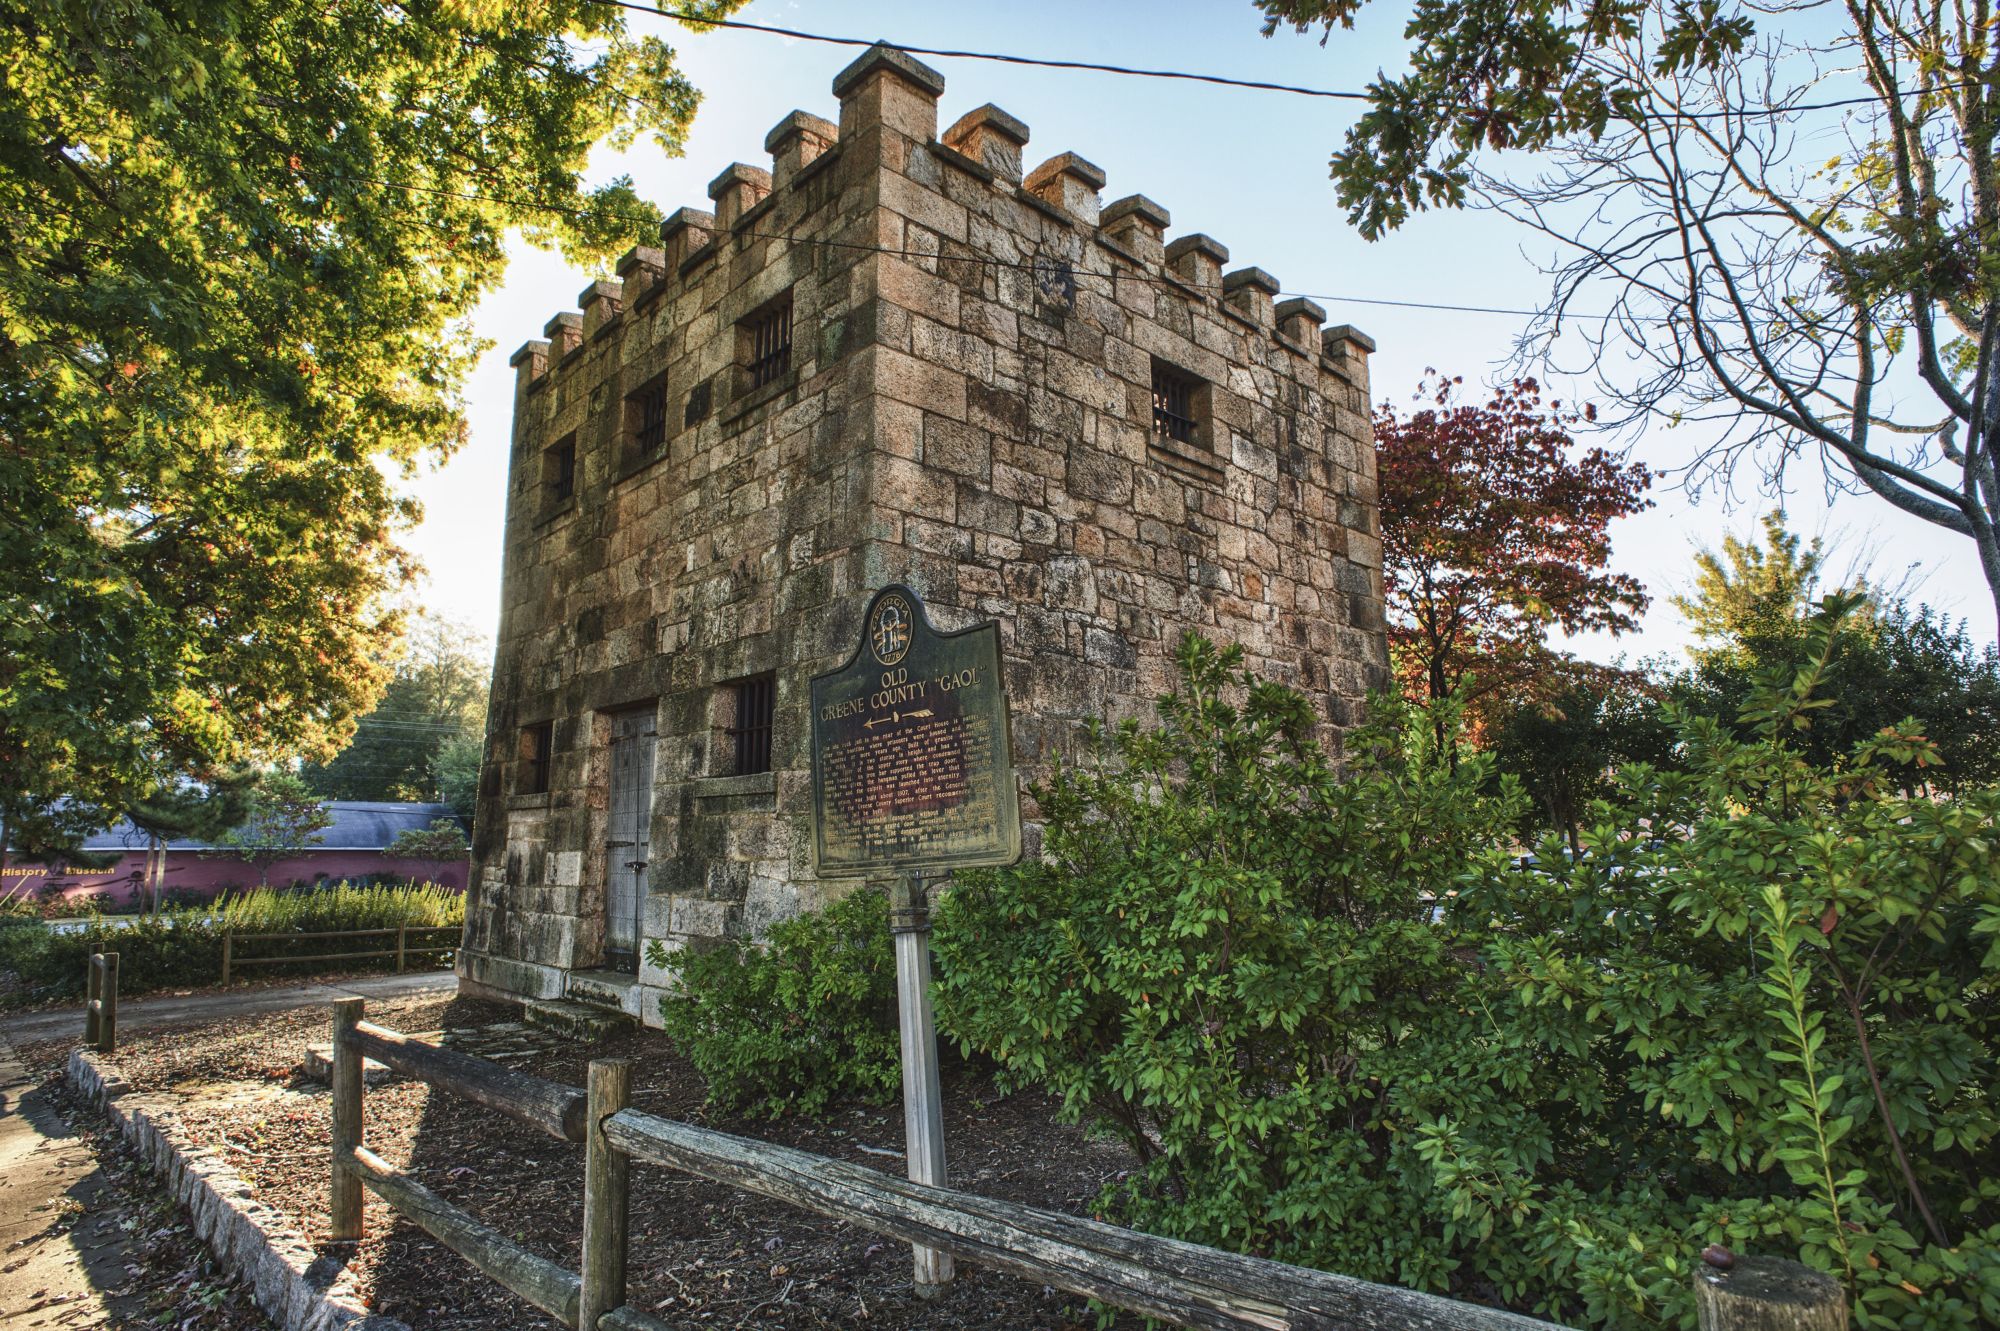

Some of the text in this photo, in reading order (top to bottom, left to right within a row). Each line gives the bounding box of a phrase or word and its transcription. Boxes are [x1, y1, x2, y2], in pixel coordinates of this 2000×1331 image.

[873, 598, 908, 631] GEORGIA
[881, 668, 908, 688] OLD
[820, 666, 987, 721] GREENE COUNTY "GAOL"
[917, 724, 931, 732] Court
[934, 720, 949, 728] House
[887, 737, 908, 746] prisoners
[929, 729, 947, 737] housed
[934, 735, 953, 743] granite
[932, 750, 961, 759] condemned
[890, 766, 912, 774] supported
[878, 775, 898, 783] hangman
[898, 779, 920, 787] launched
[937, 773, 961, 781] eternity.
[945, 781, 966, 789] General
[875, 800, 892, 808] County
[894, 797, 914, 805] Superior
[918, 794, 932, 802] Court
[919, 810, 939, 818] without
[1, 866, 115, 877] History Museum
